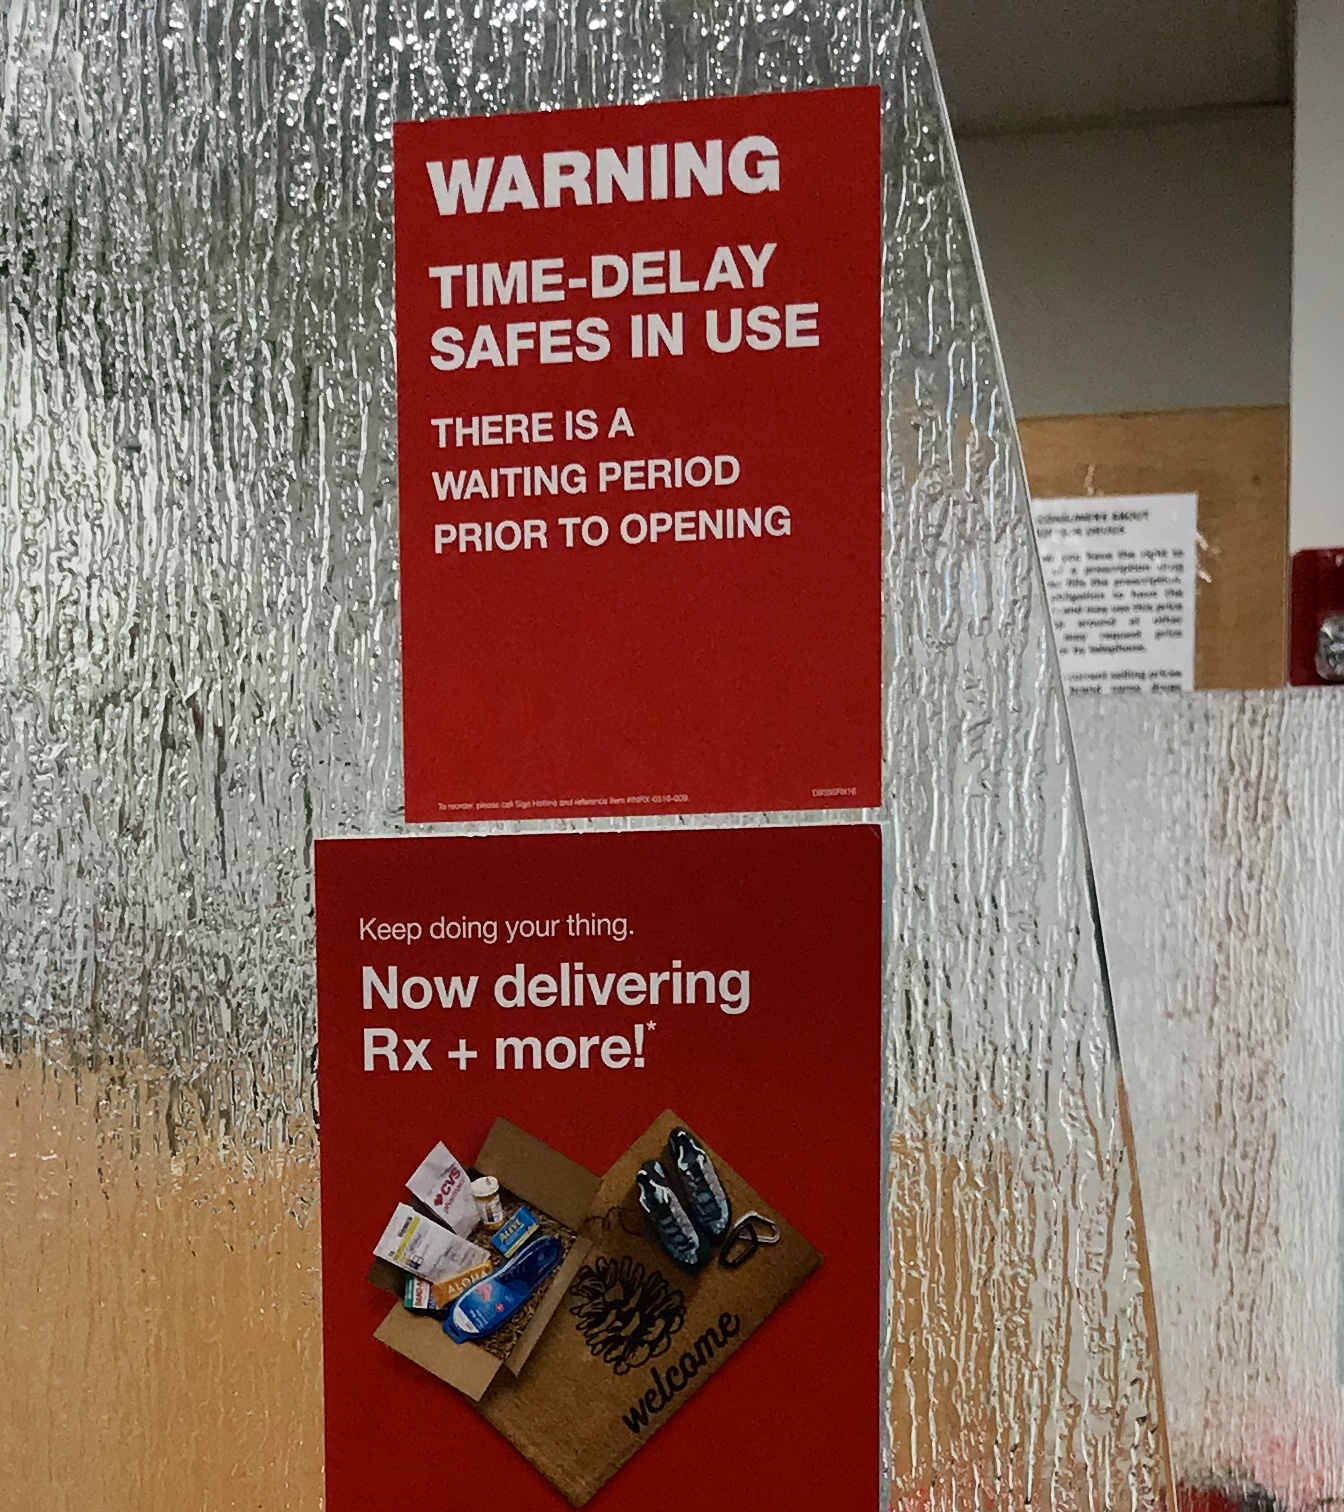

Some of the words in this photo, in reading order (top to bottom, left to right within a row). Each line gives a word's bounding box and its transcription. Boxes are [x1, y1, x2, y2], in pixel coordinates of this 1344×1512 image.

[426, 135, 781, 217] WARNING
[429, 243, 777, 310] TIME-DELAY
[430, 316, 611, 372] SAFES
[631, 312, 684, 358] IN
[704, 302, 820, 353] USE
[431, 412, 553, 449] THERE
[564, 410, 599, 442] IS
[608, 407, 634, 438] A
[432, 463, 588, 501] WAITING
[598, 455, 740, 492] PERIOD
[434, 519, 548, 554] PRIOR
[558, 516, 609, 549] TO
[619, 506, 791, 544] OPENING
[359, 918, 422, 945] Keep
[430, 916, 498, 943] doing
[505, 919, 560, 943] your
[566, 914, 634, 941] thing.
[362, 965, 478, 1010] Now
[494, 960, 751, 1014] delivering
[363, 1028, 432, 1072] Rx
[448, 1038, 478, 1070] +
[440, 1166, 461, 1196] CVS
[622, 1312, 740, 1433] welcome
